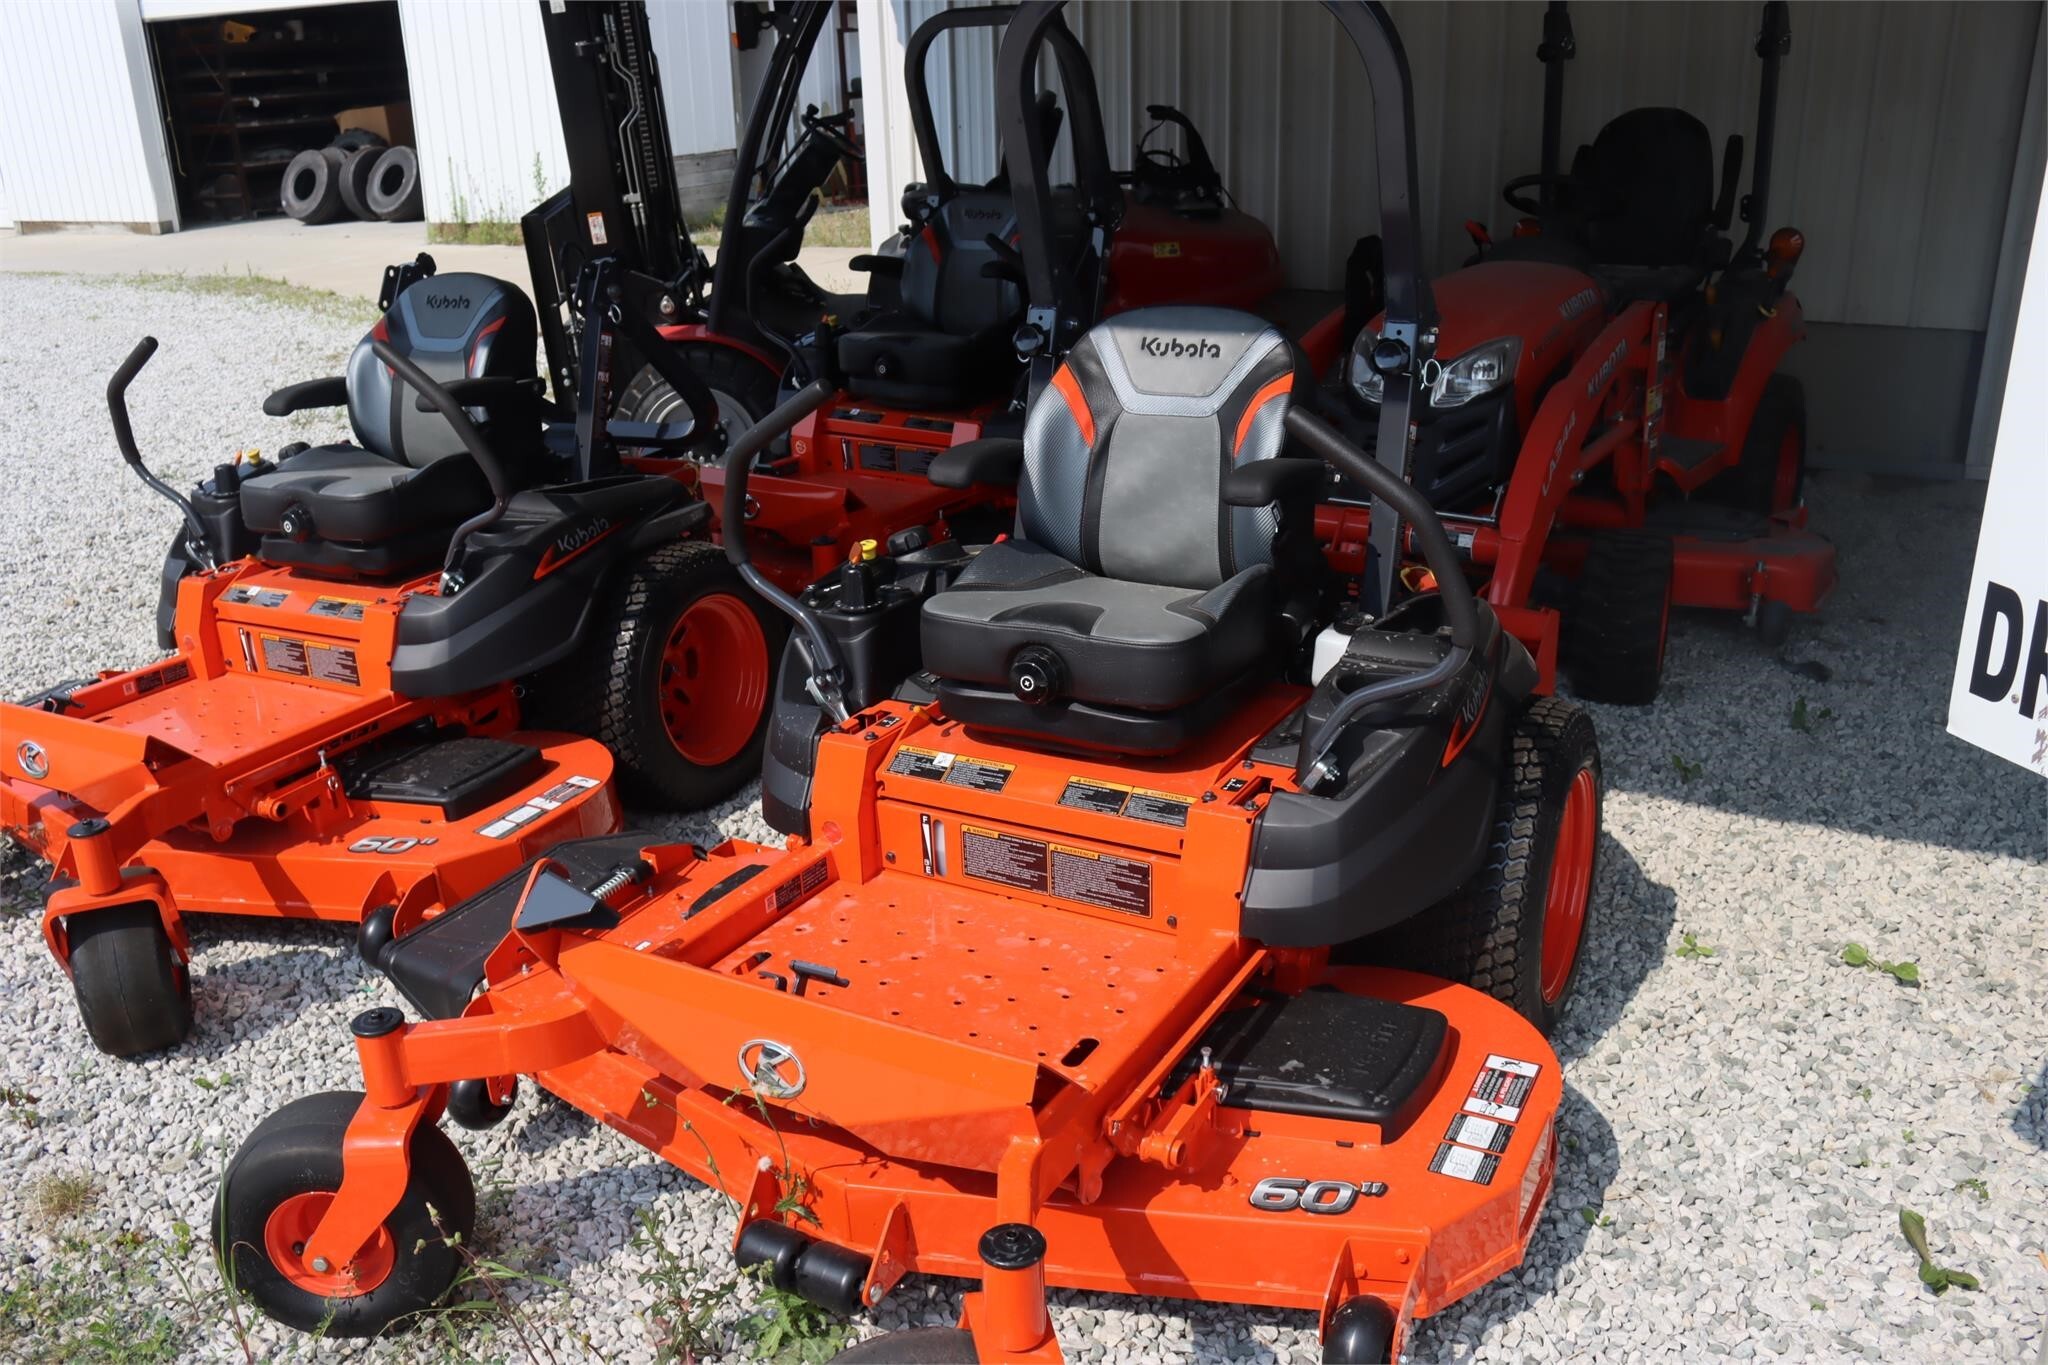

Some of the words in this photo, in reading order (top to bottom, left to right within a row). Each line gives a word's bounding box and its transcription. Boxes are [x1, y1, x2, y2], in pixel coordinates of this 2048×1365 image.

[426, 294, 470, 309] Kubota
[1559, 287, 1598, 320] KUBOTA
[1140, 336, 1221, 358] Kubota
[1587, 338, 1629, 400] KUBOTA
[557, 517, 609, 551] Kubota
